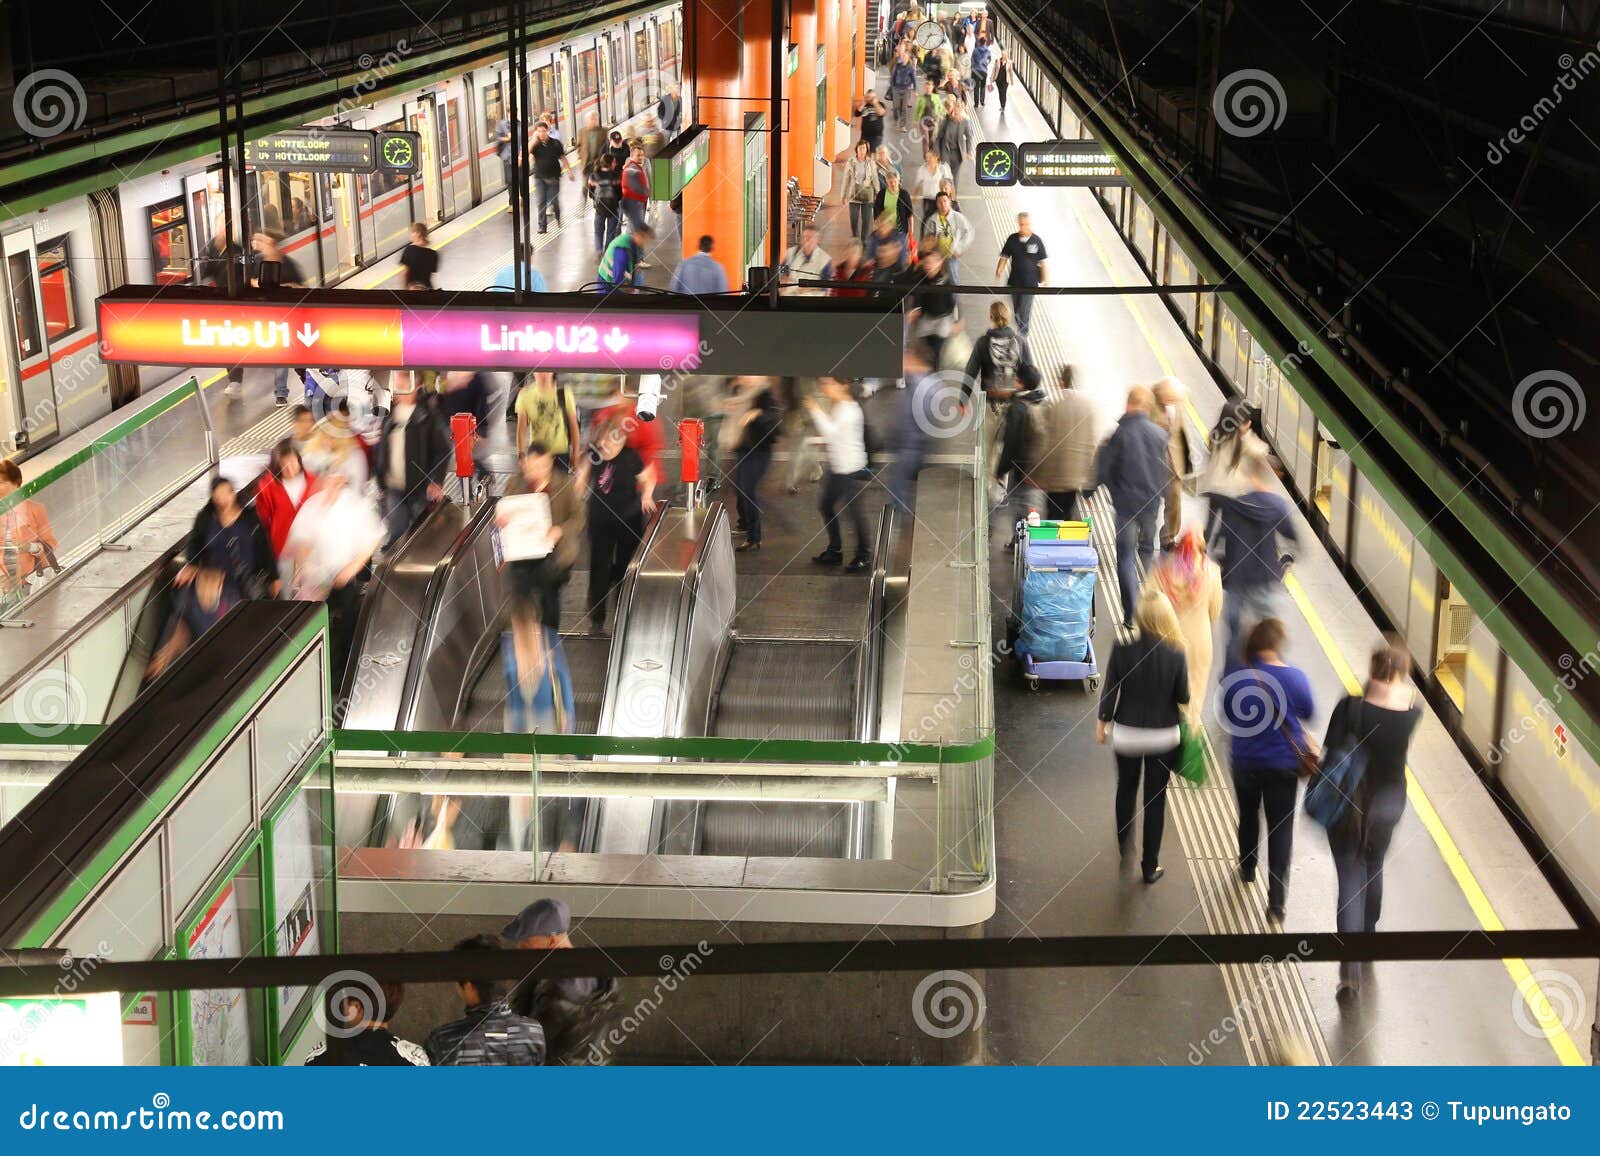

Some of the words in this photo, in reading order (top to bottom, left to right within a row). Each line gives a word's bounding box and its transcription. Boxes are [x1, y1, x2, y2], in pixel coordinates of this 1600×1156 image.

[182, 319, 250, 346] Linie
[254, 321, 290, 348] U1
[481, 324, 553, 351] Linie
[556, 325, 598, 353] U2
